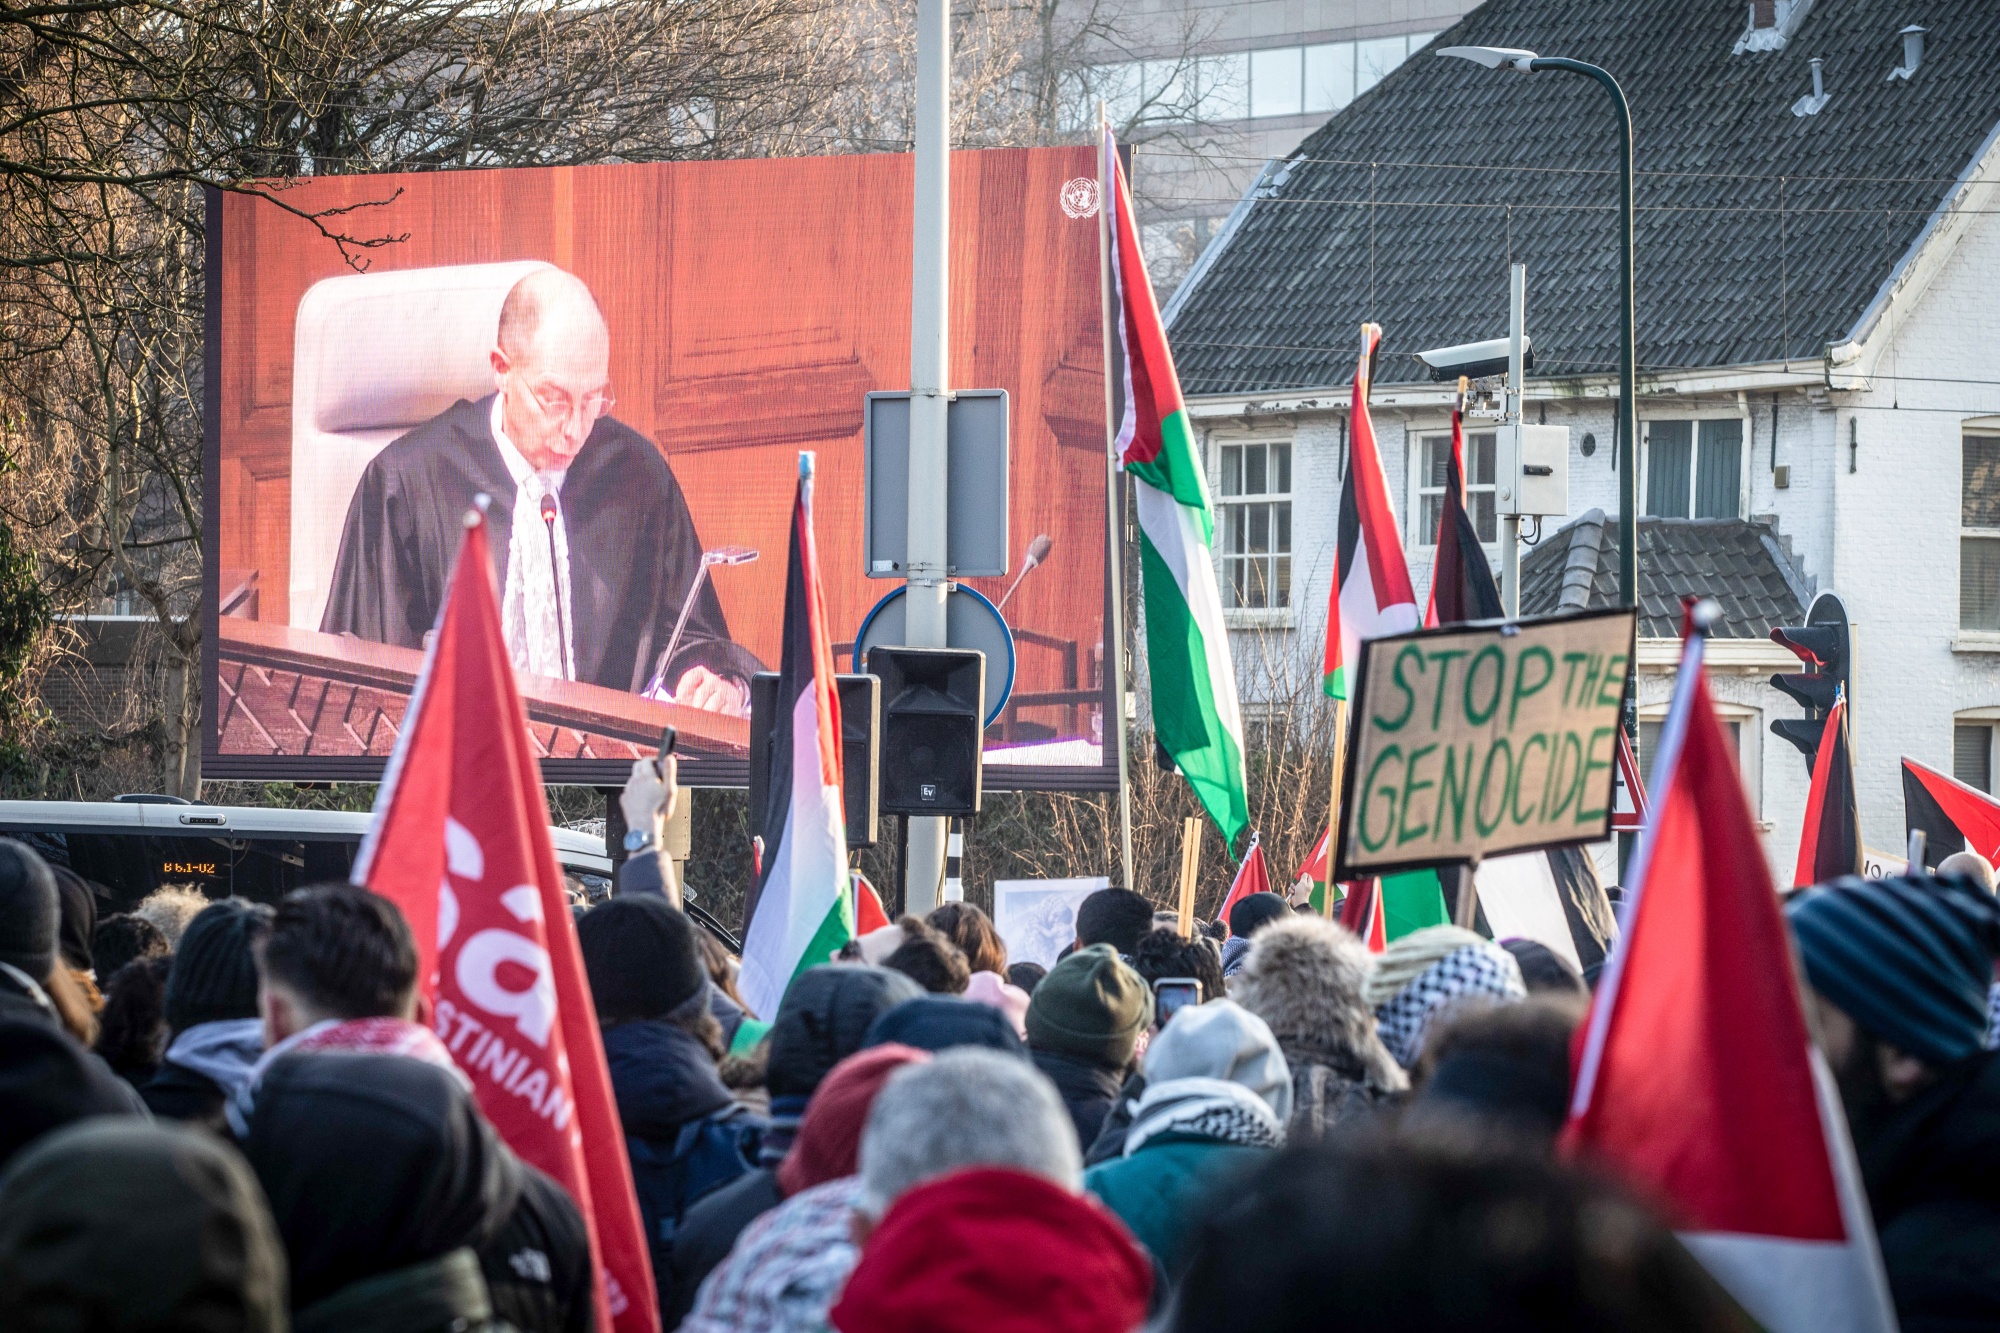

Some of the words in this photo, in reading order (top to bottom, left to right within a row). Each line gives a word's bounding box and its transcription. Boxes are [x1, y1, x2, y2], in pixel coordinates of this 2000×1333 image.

[1372, 642, 1556, 732] STOP
[1562, 649, 1629, 709] THE
[1357, 726, 1615, 854] GENOCIDE
